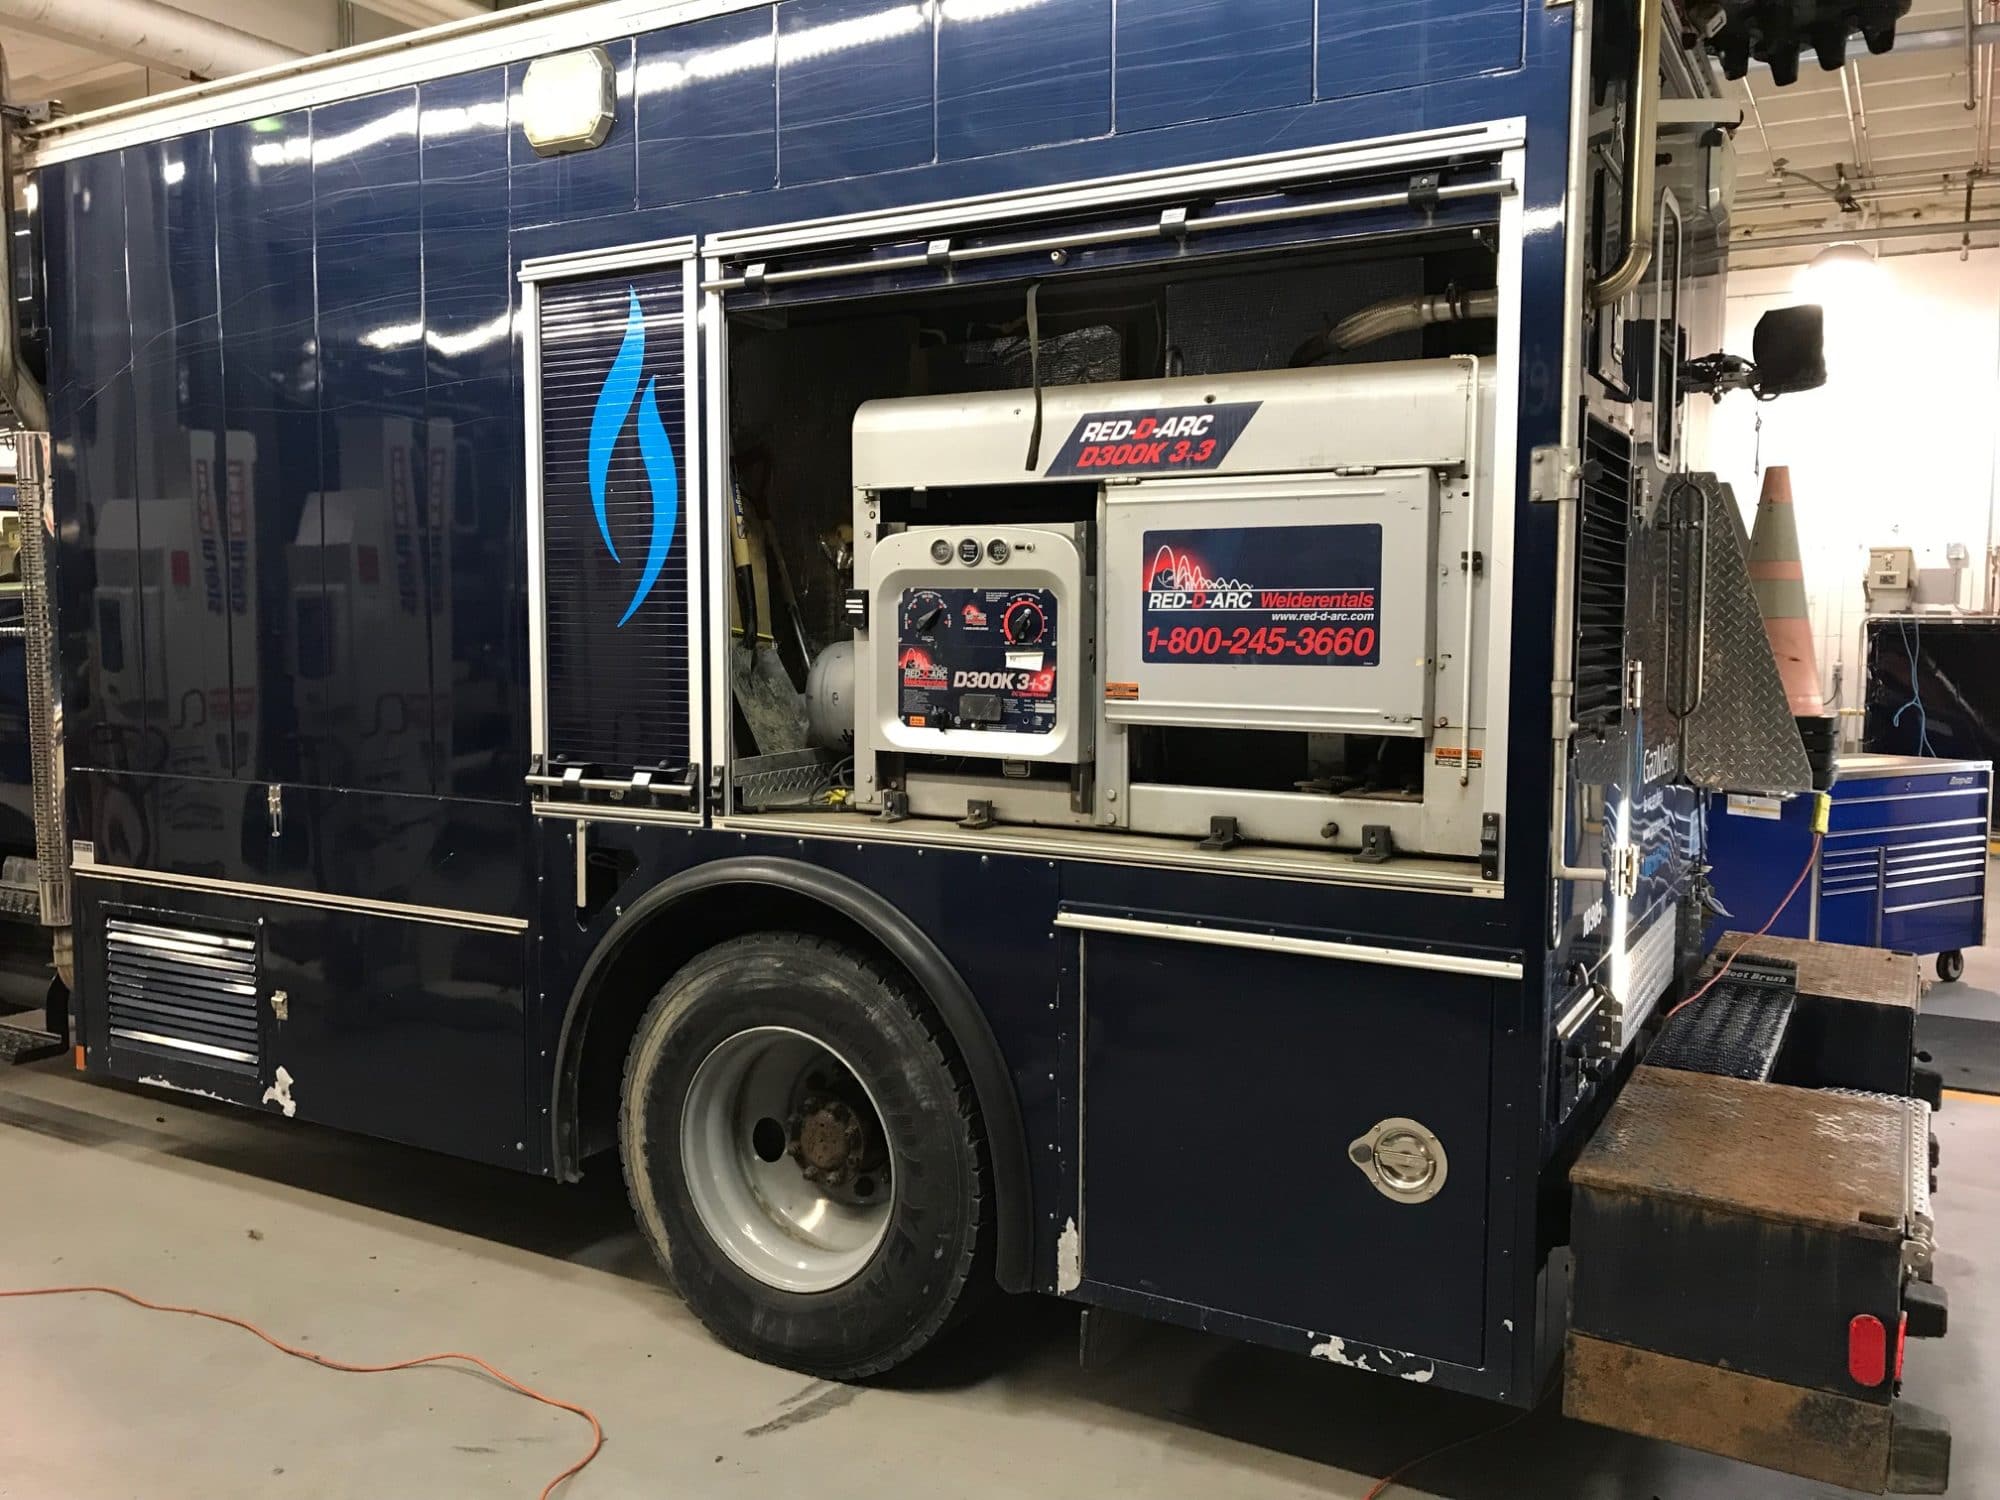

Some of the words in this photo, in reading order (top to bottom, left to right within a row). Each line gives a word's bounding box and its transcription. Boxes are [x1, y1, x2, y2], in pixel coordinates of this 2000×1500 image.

[1079, 414, 1214, 443] RED-D-ARC
[1076, 442, 1169, 467] D300K
[1148, 592, 1253, 609] RED-D-ARC
[1260, 591, 1374, 608] Welderentals
[1271, 611, 1374, 622] www.red-d-arc.com
[1147, 626, 1375, 656] 1-800-245-3660
[953, 671, 1015, 690] D300K
[1016, 673, 1052, 691] 3+3
[1750, 973, 1788, 983] Brush
